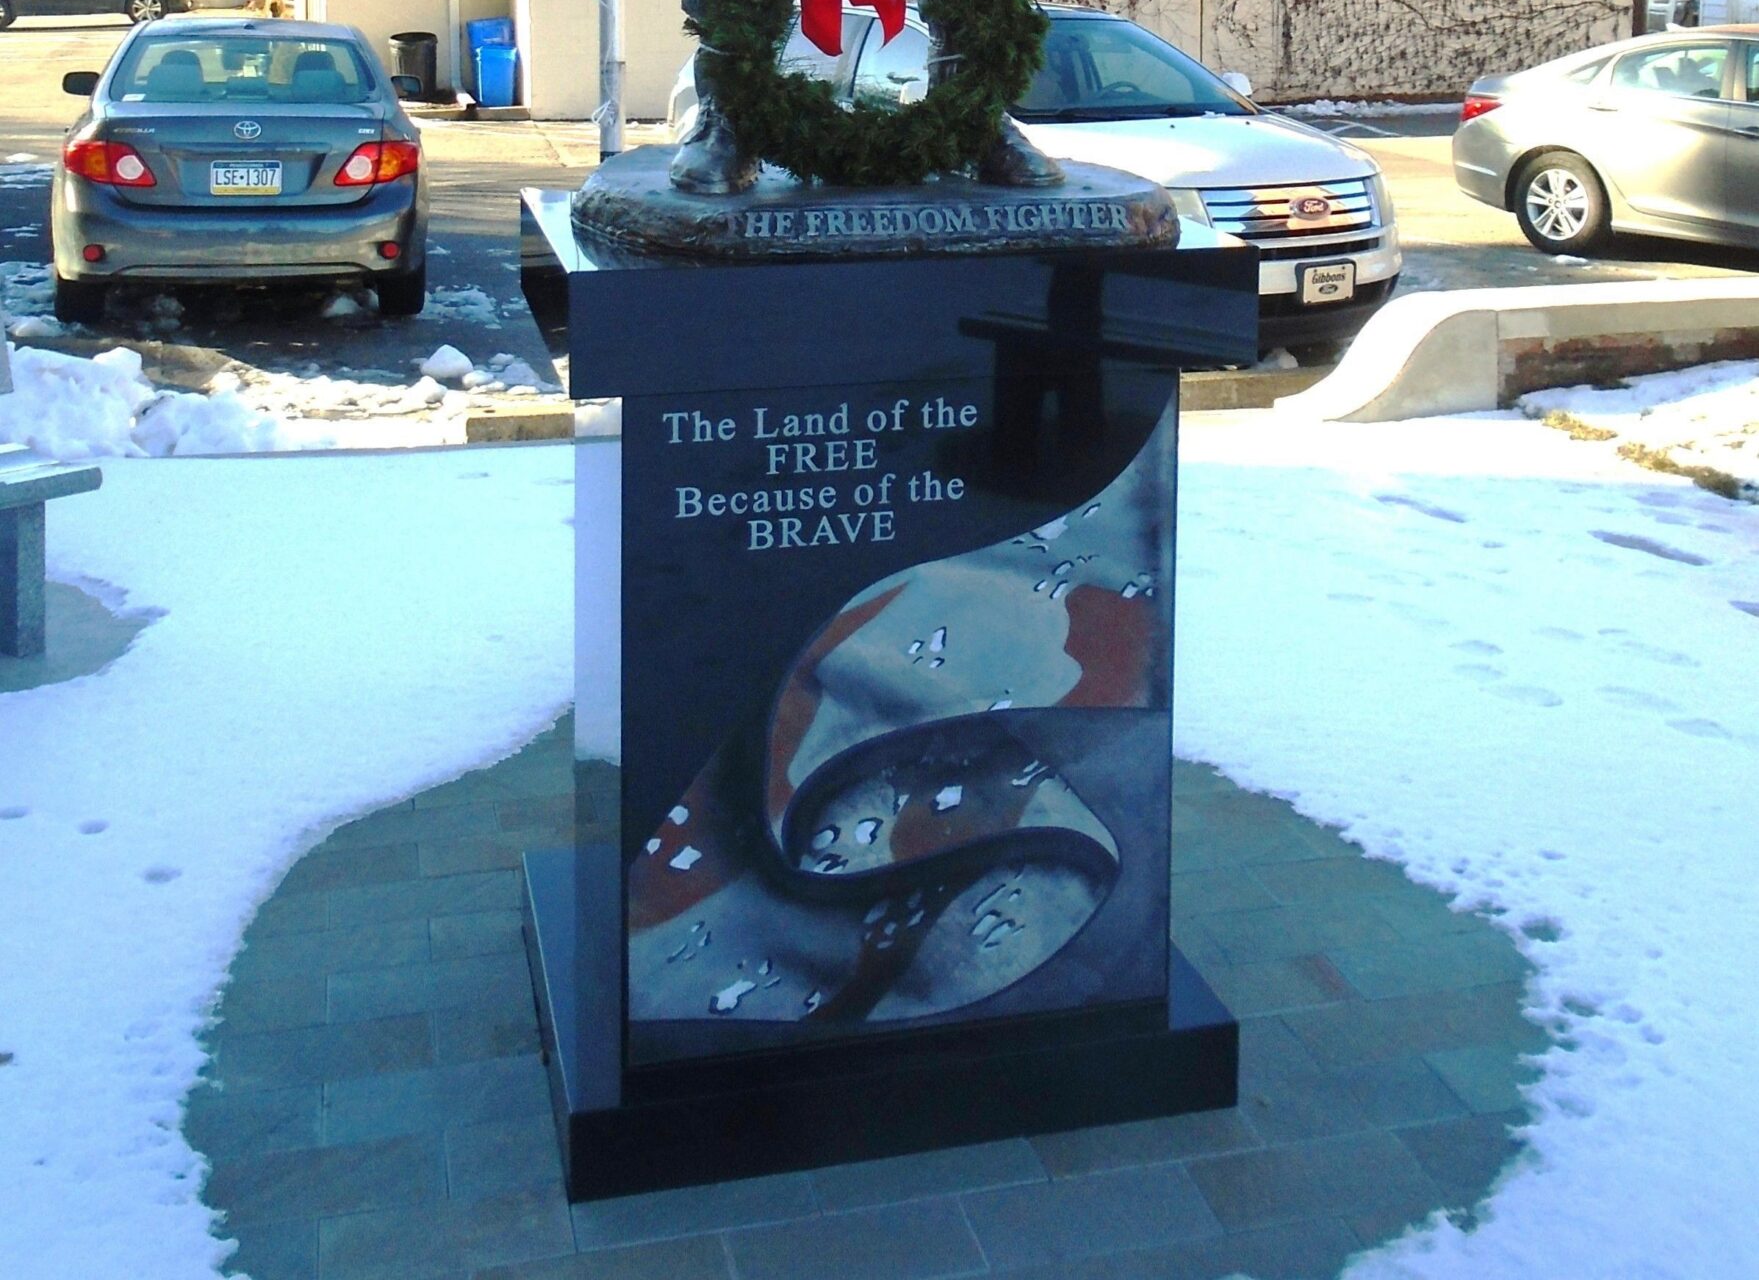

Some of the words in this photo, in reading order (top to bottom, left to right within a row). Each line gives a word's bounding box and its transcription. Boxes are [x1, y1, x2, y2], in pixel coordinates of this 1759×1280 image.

[724, 210, 795, 238] THE
[804, 206, 977, 237] FREEDOM
[984, 203, 1129, 232] FIGHTER
[1312, 271, 1346, 285] Gibbons
[662, 410, 737, 444] The
[753, 402, 850, 439] Land
[866, 399, 910, 432] of
[921, 397, 978, 429] the
[765, 439, 879, 475] FREE
[674, 485, 838, 519] Because
[854, 473, 897, 506] of
[908, 470, 965, 503] the
[746, 510, 896, 551] BRAVE
